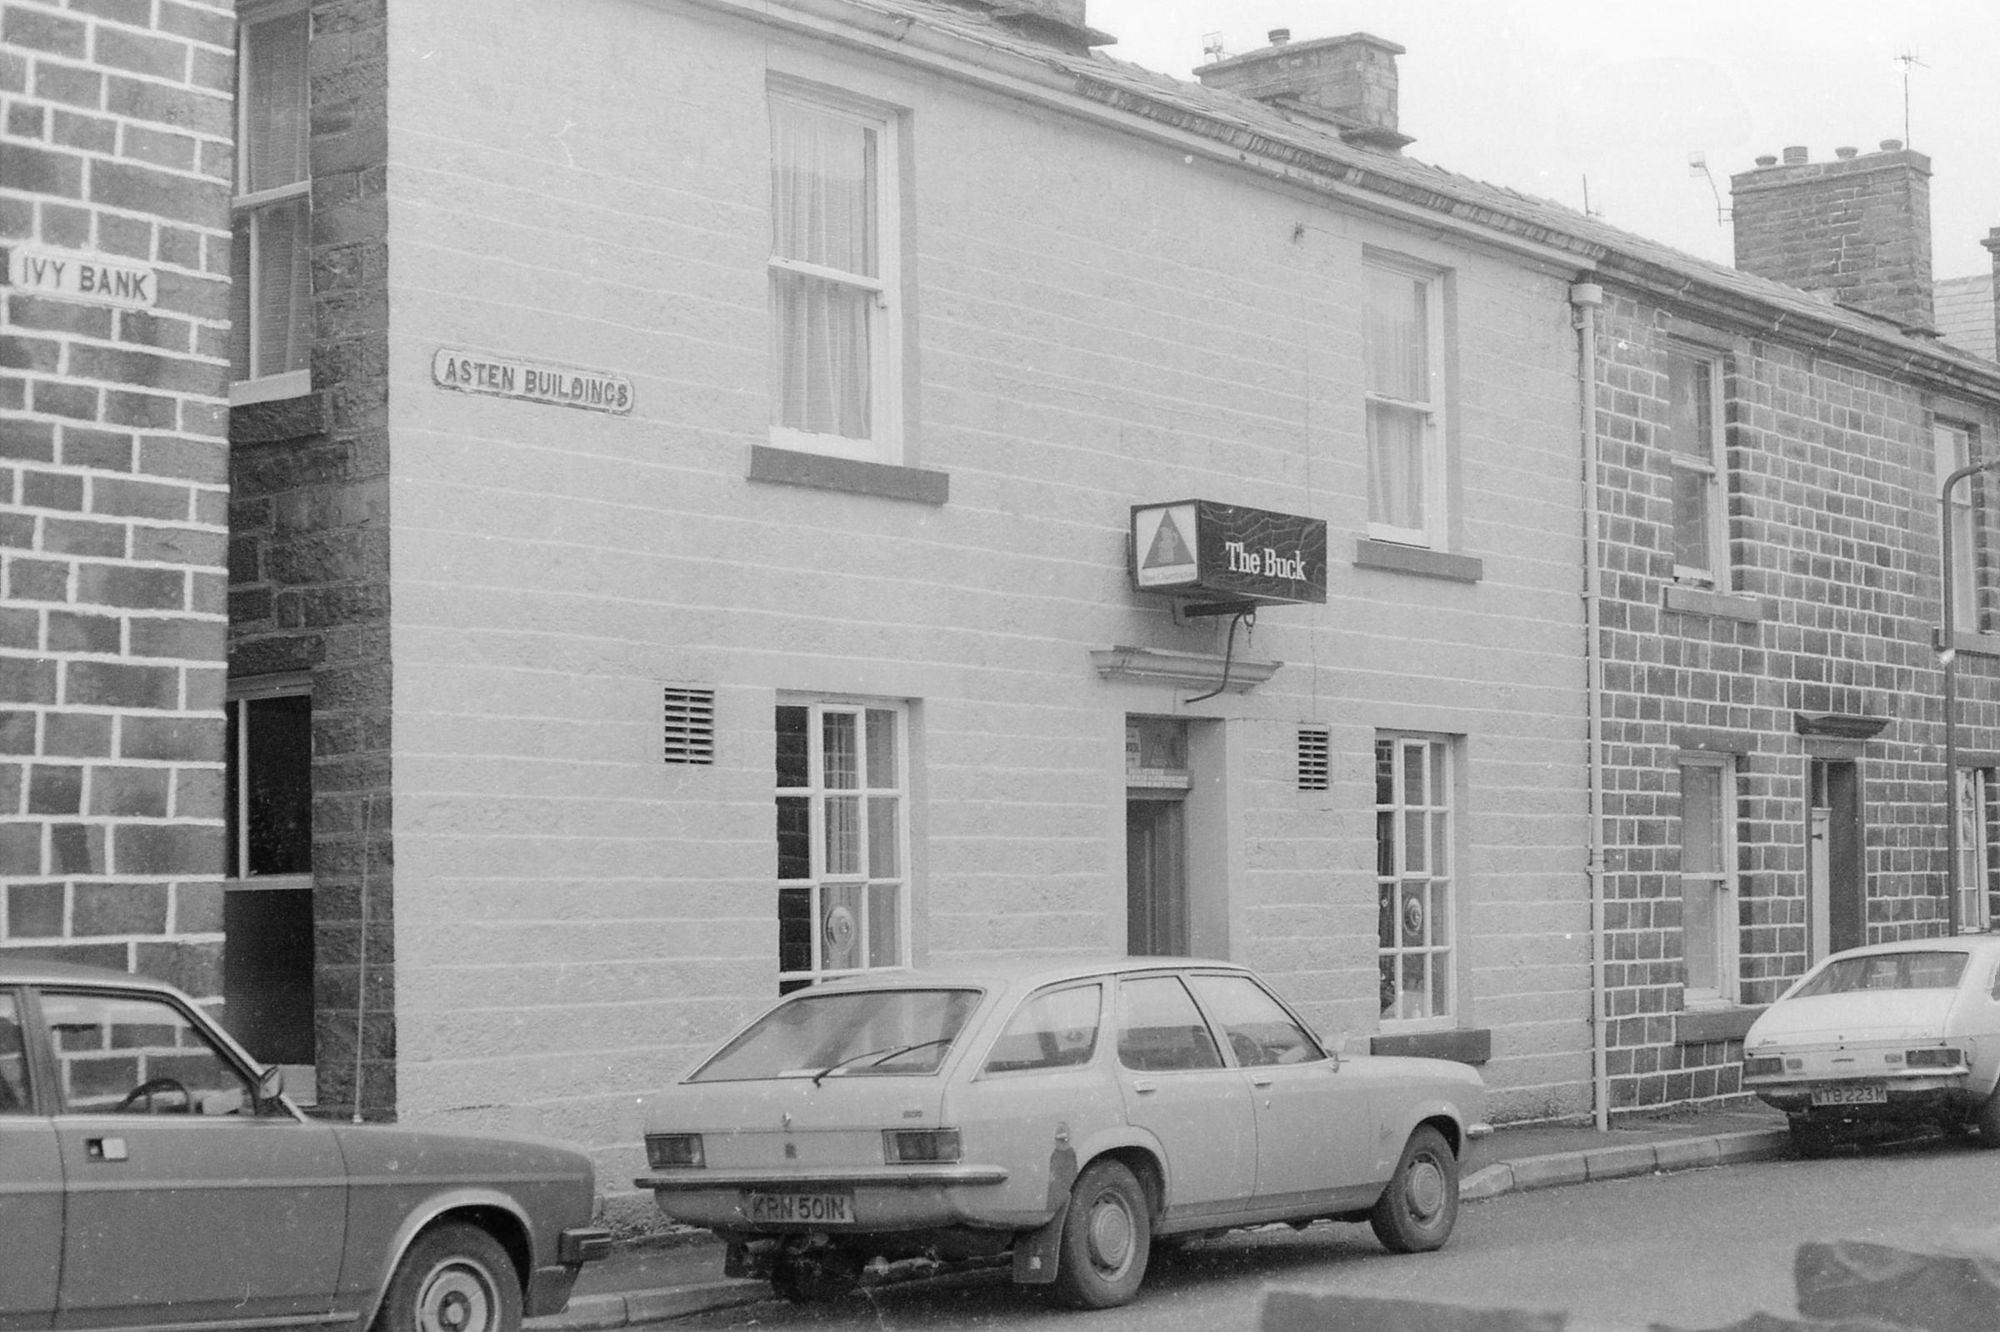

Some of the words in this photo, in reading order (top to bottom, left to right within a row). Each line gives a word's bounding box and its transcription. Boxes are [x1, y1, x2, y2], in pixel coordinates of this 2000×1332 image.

[24, 257, 66, 286] IVY
[80, 266, 148, 300] BANK
[445, 357, 515, 390] ASTEN
[525, 370, 628, 407] BUILDINGS
[1225, 542, 1260, 574] The
[1264, 548, 1306, 580] Buck
[1845, 1087, 1886, 1102] 223M
[752, 1196, 793, 1219] KRN
[799, 1197, 845, 1219] 501N
